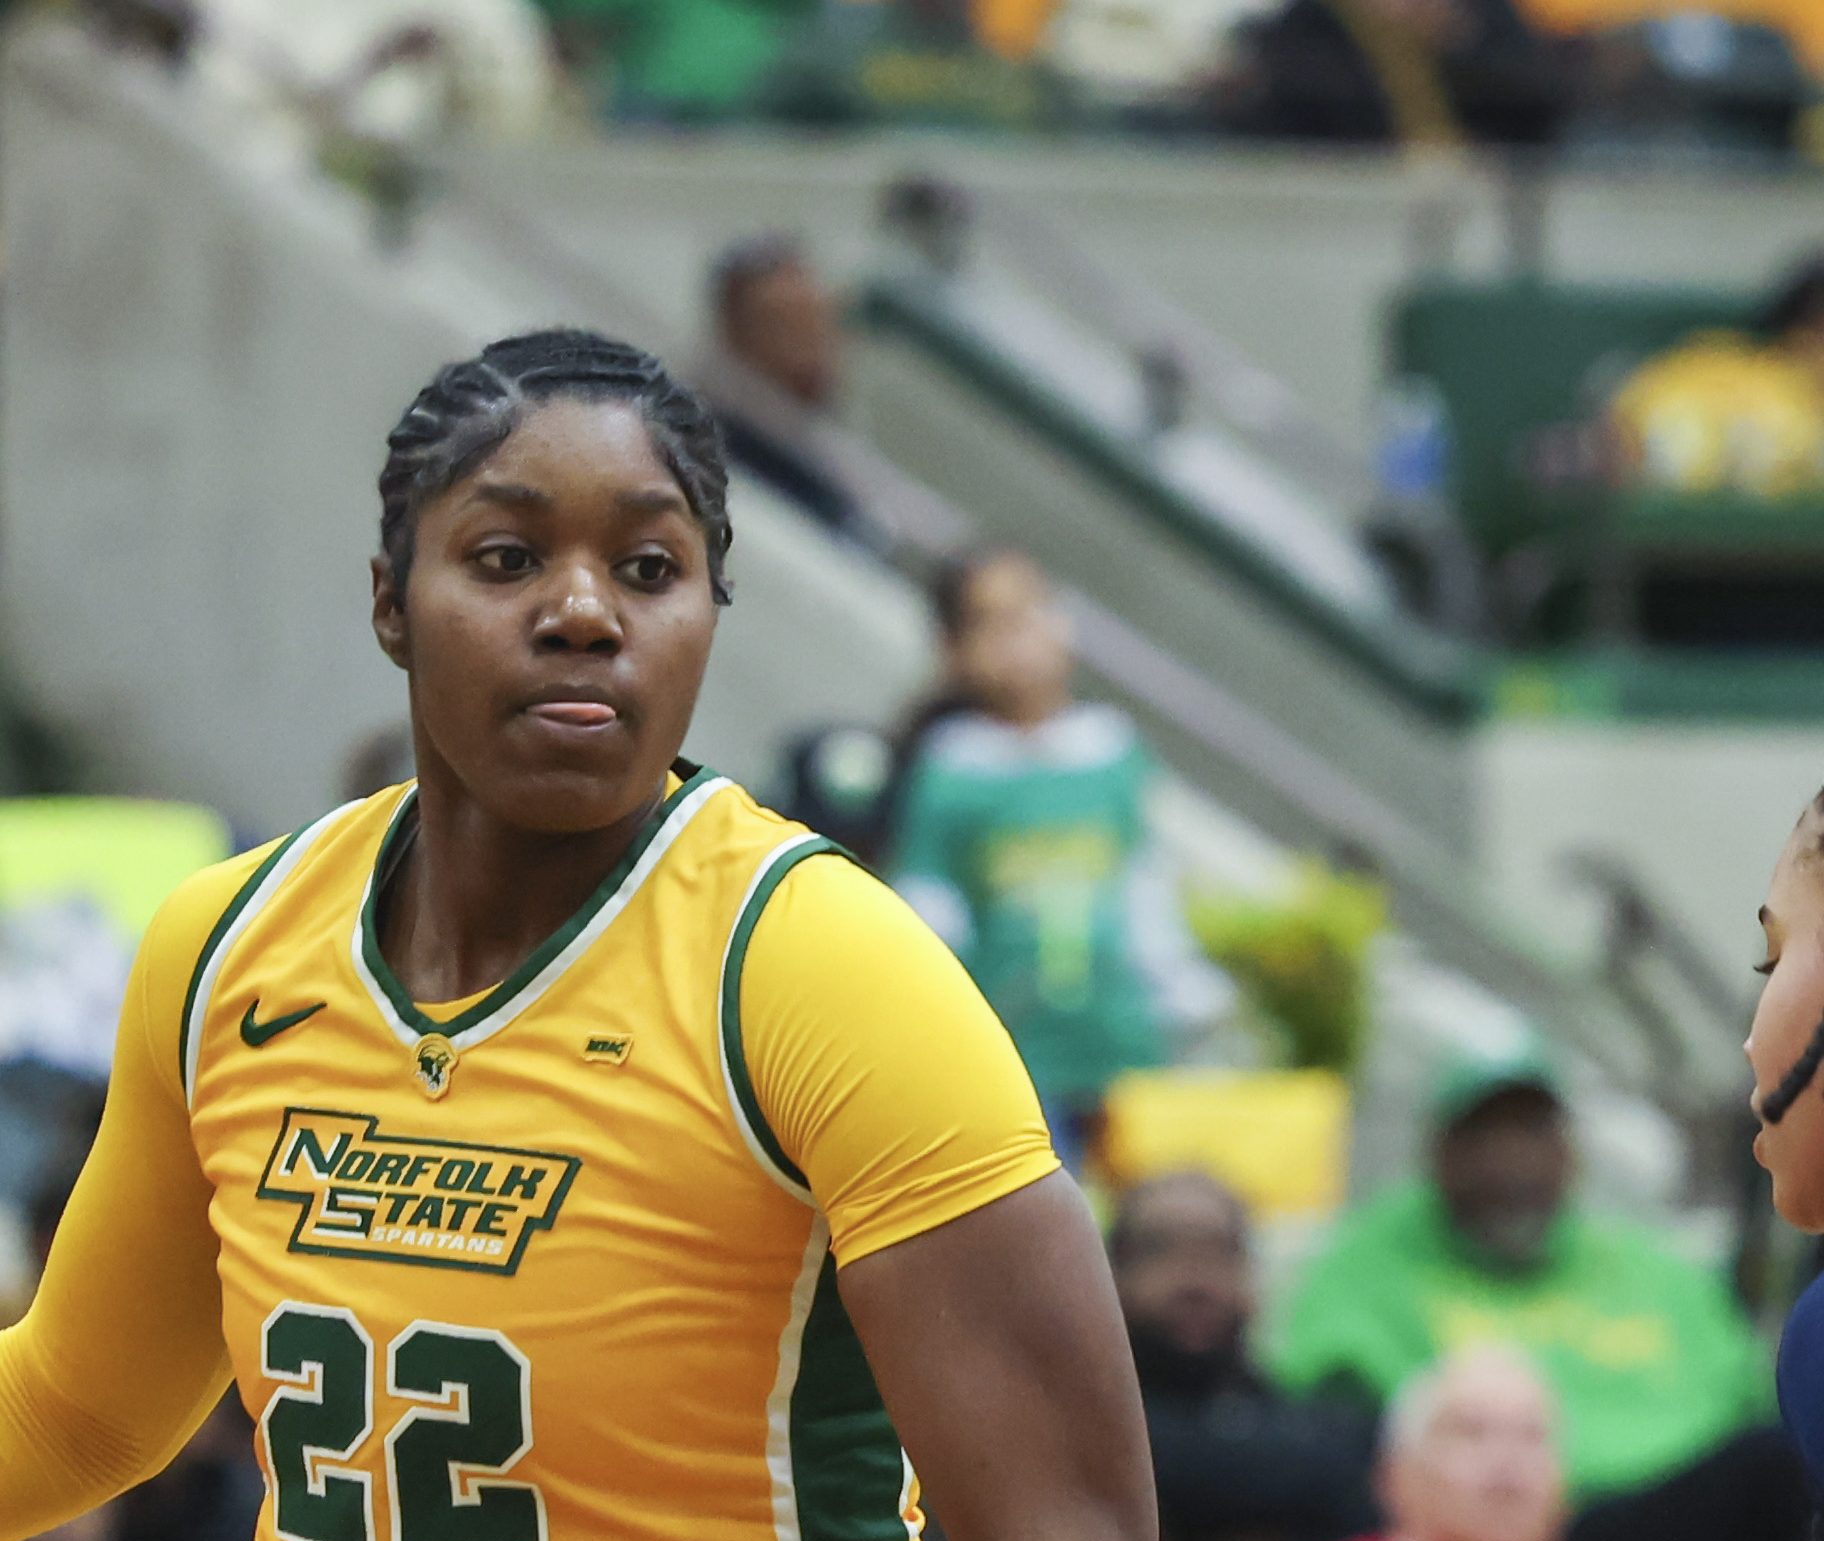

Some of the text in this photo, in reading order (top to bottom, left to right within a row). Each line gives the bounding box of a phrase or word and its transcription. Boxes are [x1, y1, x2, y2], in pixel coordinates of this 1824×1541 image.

[278, 1128, 548, 1200] NORFOLK
[312, 1186, 518, 1240] STATE
[371, 1226, 505, 1257] SPARTANS
